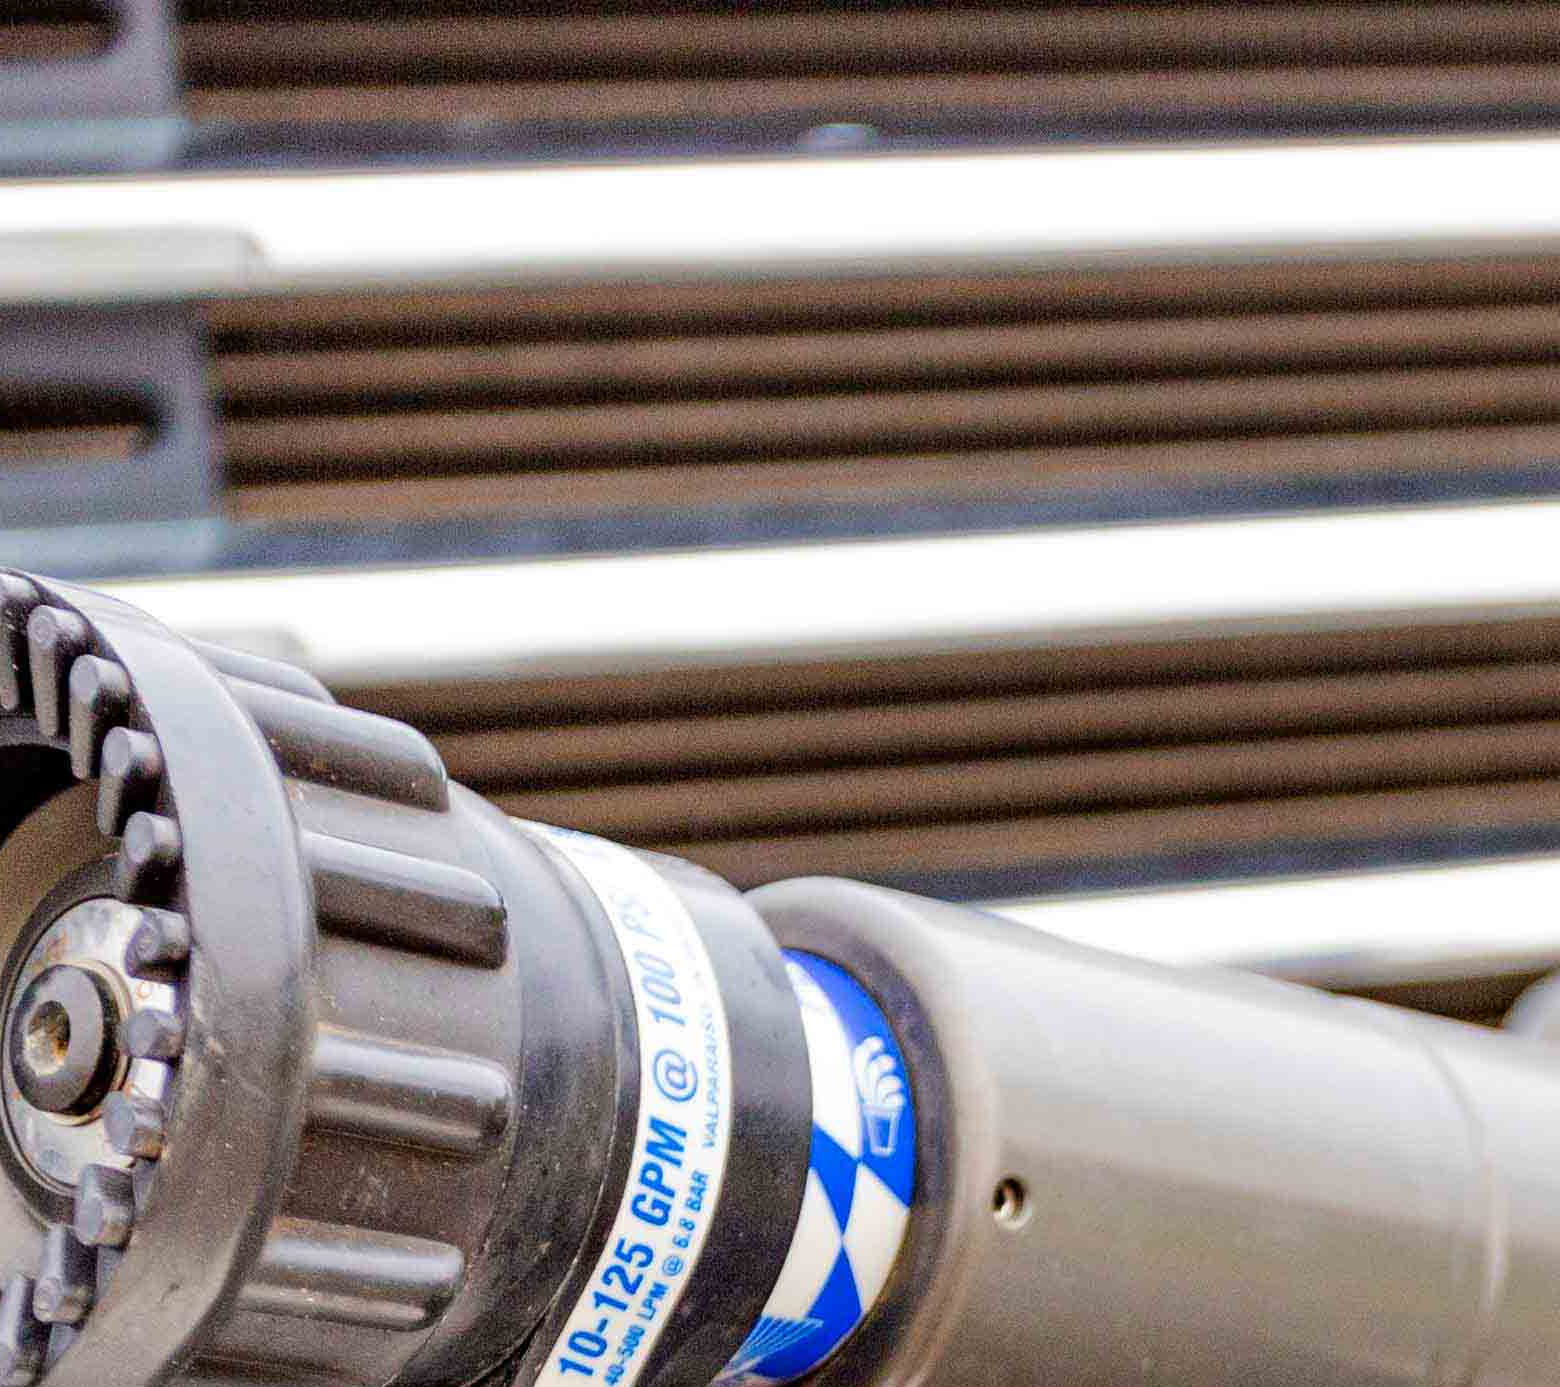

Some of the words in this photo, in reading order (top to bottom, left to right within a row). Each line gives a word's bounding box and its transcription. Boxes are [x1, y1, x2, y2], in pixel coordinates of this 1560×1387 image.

[638, 959, 686, 1035] 100
[652, 1048, 699, 1103] @
[629, 1116, 688, 1225] GPM
[638, 1282, 668, 1326] LPM
[684, 1170, 711, 1215] BAR
[558, 1238, 656, 1379] 10-125
